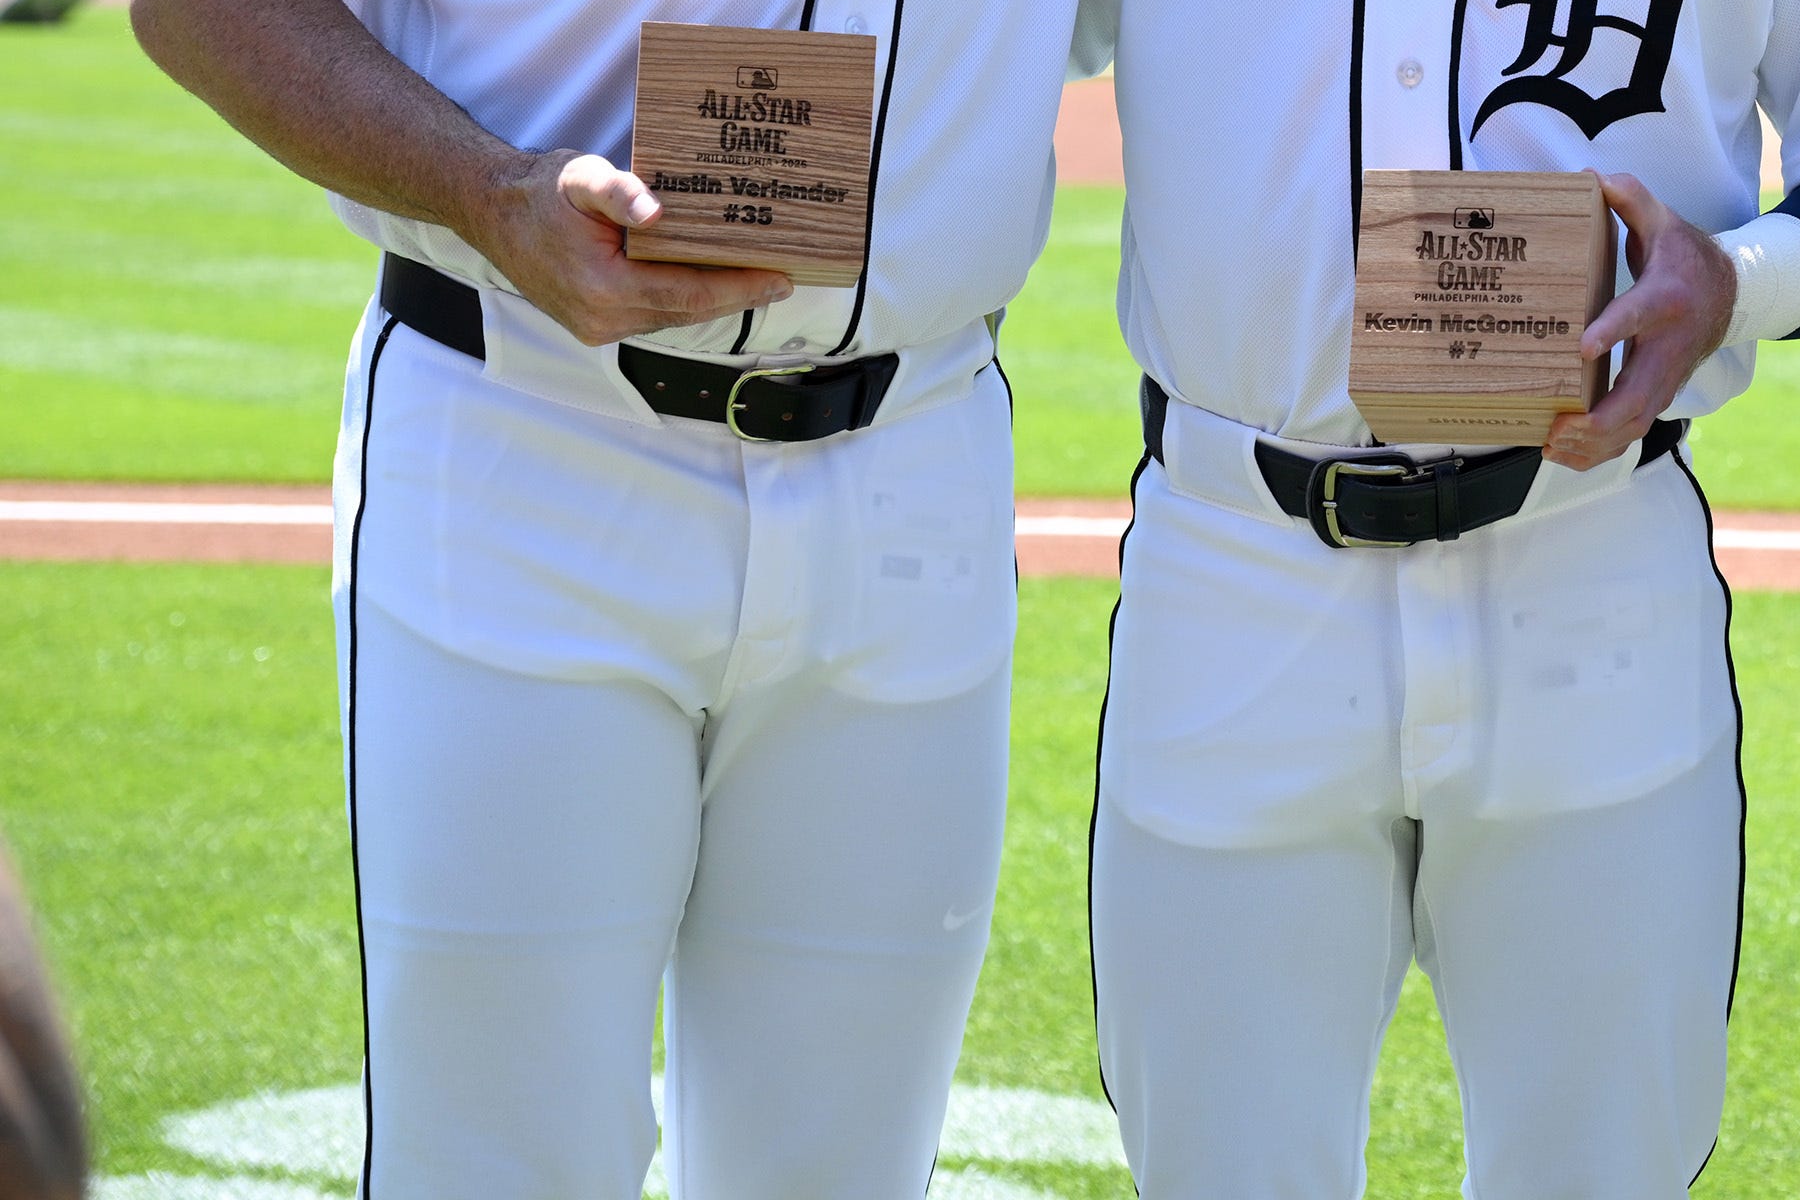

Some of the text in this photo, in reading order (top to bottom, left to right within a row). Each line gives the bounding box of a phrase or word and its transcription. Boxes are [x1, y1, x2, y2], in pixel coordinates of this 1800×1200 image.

[719, 121, 790, 156] GAME
[696, 152, 774, 168] PHILADELPHIA
[650, 171, 849, 204] Justin Verlander
[722, 203, 774, 226] #35
[1437, 261, 1506, 292] GAME
[1413, 292, 1524, 304] PHILADELPHIA 2026
[1364, 311, 1571, 340] Kevin McGonigle
[1448, 340, 1483, 360] #7
